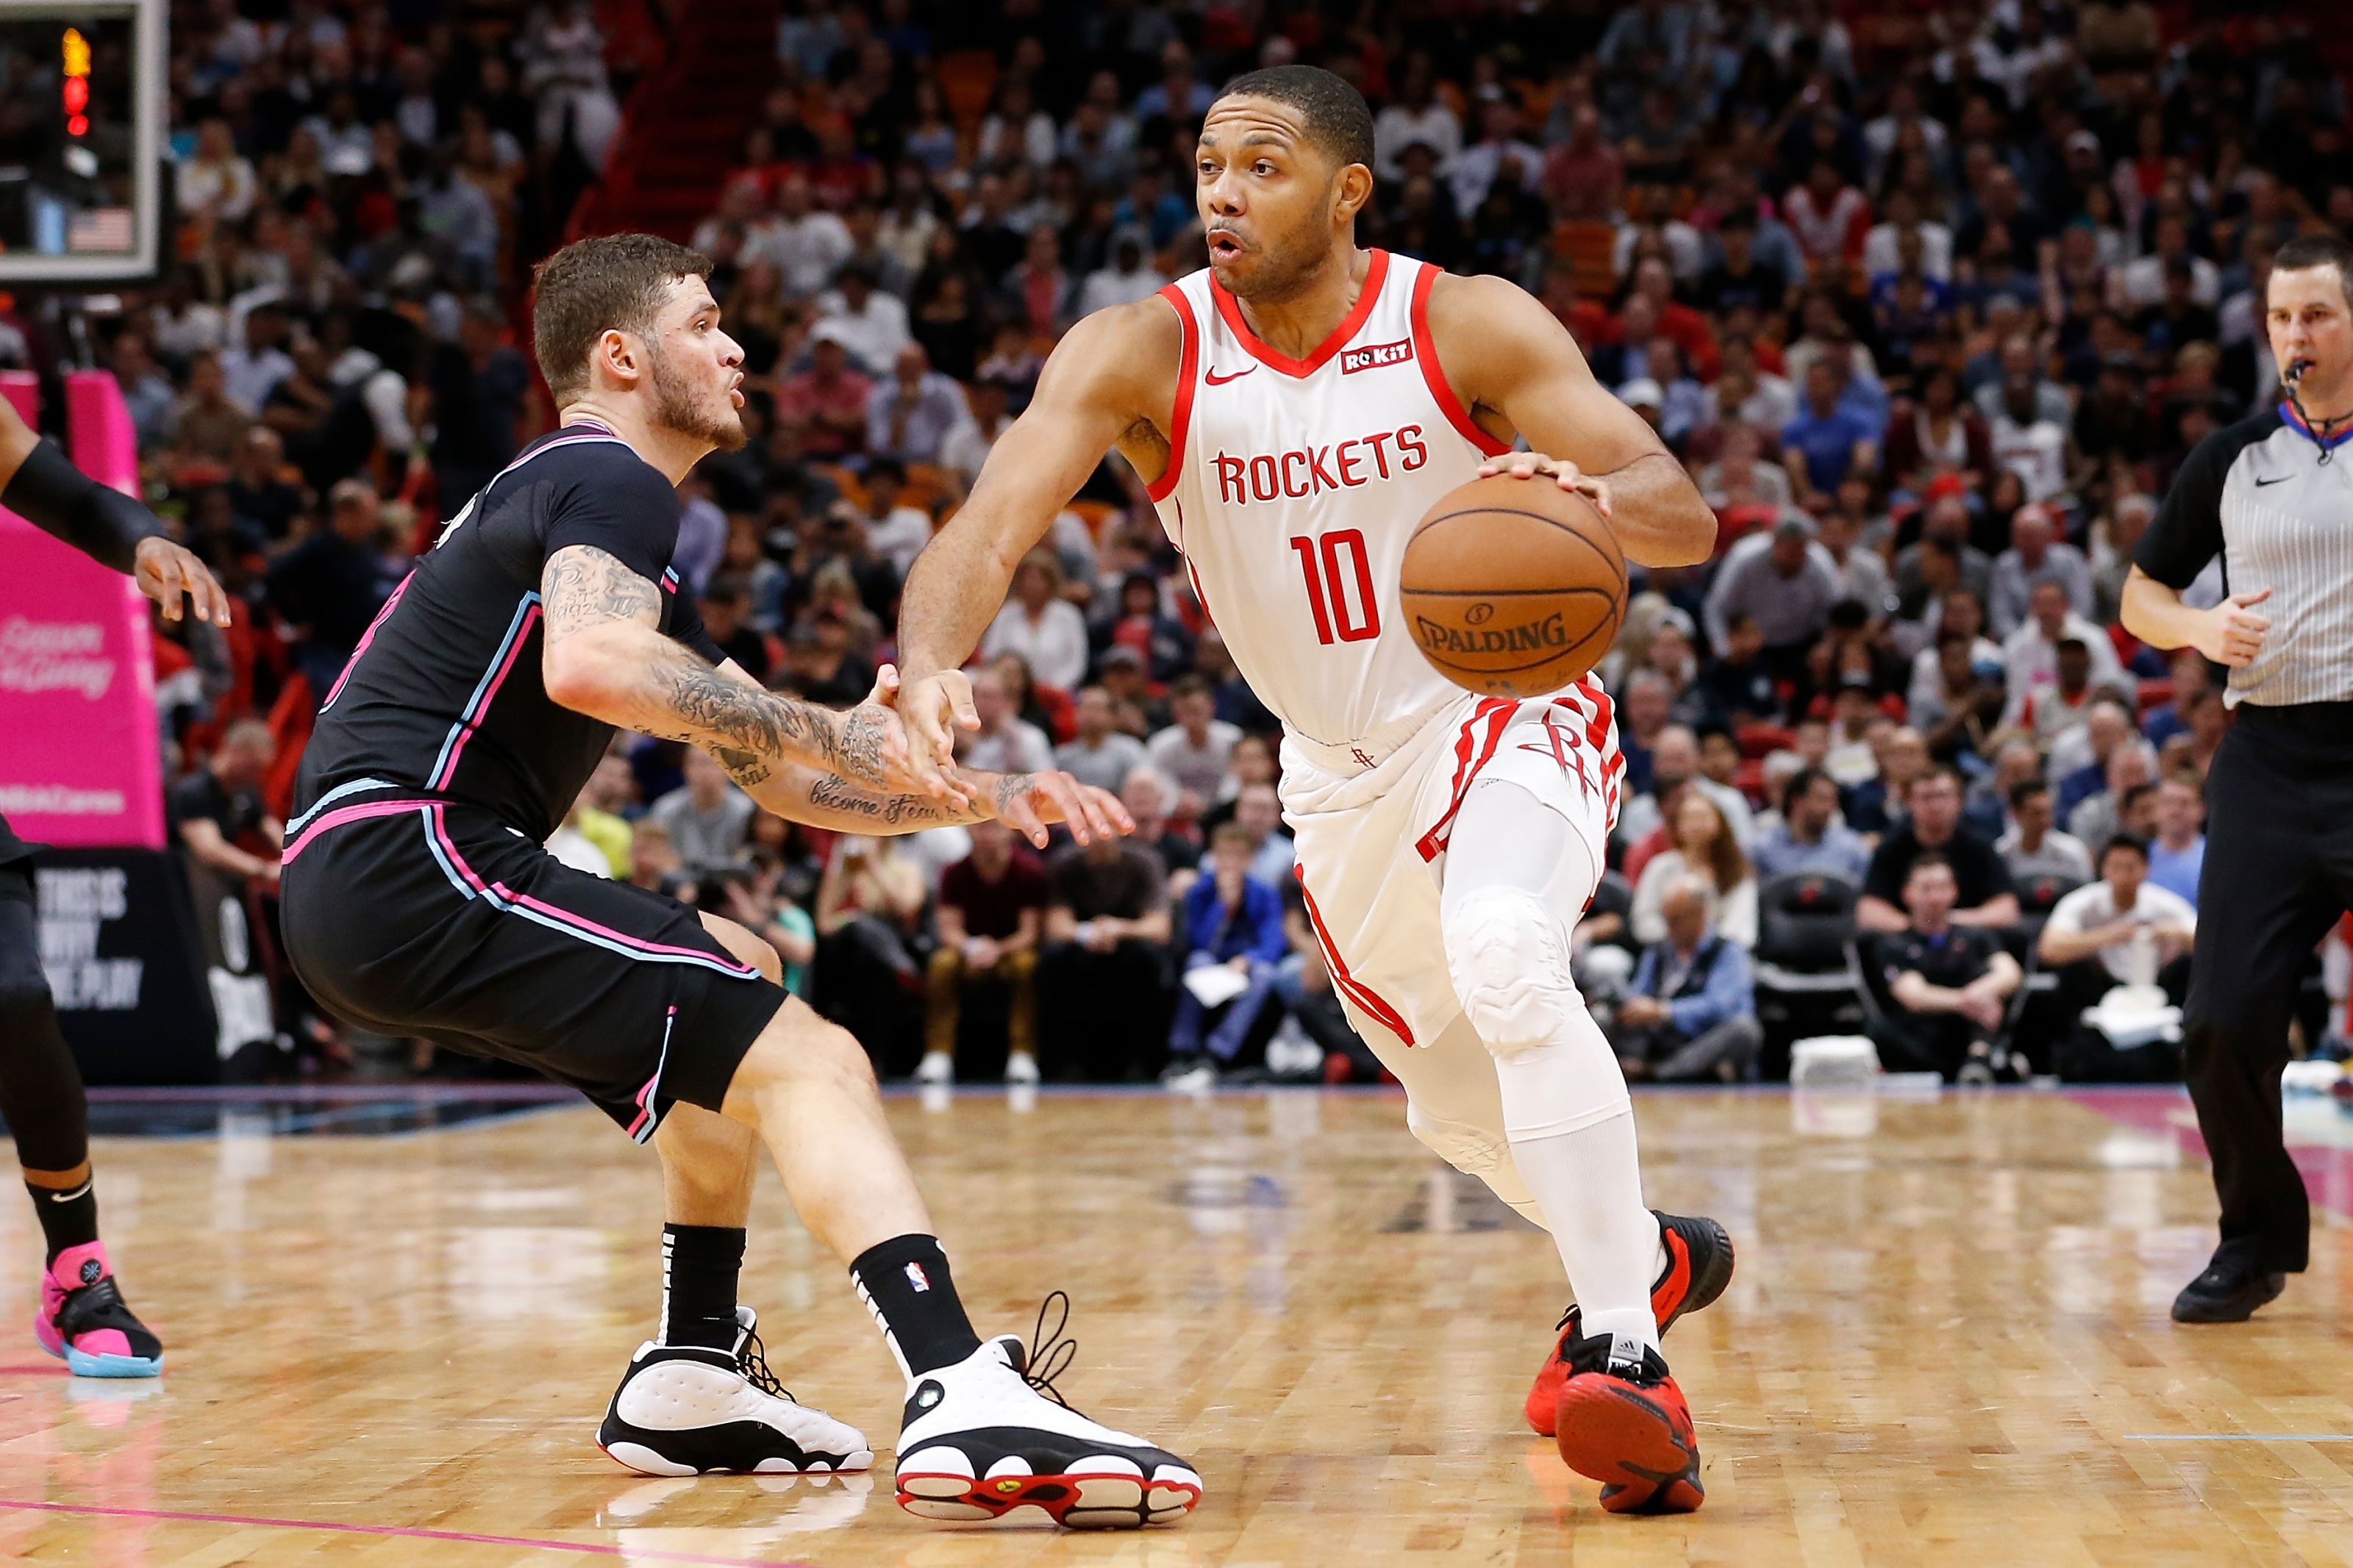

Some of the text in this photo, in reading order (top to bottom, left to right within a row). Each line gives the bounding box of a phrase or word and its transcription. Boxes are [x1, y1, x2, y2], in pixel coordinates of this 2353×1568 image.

[1210, 424, 1428, 506] ROCKETS
[1289, 529, 1382, 645] 10
[1416, 612, 1568, 653] SPALDING
[810, 779, 881, 815] become
